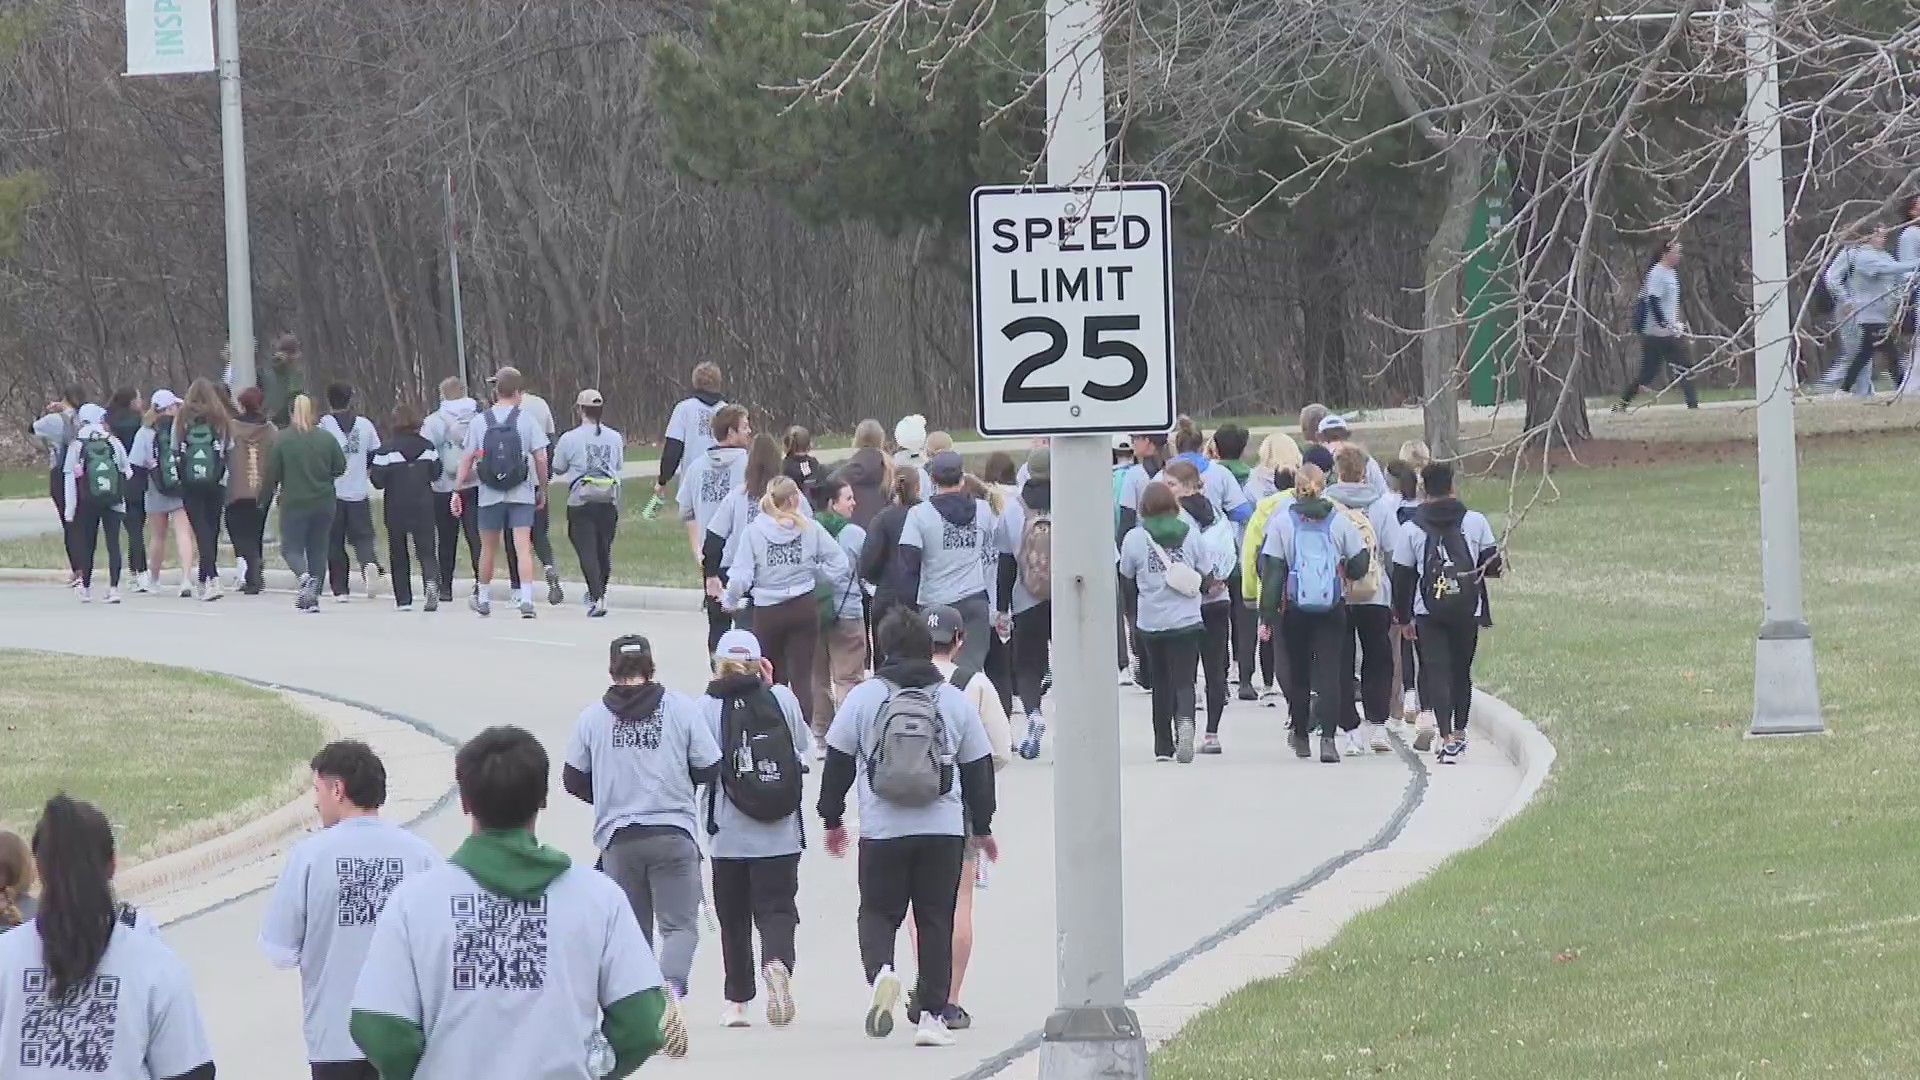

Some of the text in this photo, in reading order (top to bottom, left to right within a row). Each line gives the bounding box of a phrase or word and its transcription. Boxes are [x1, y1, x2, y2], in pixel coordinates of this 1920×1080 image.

[992, 215, 1151, 253] SPEED
[1010, 266, 1133, 304] LIMIT
[1000, 314, 1149, 403] 25
